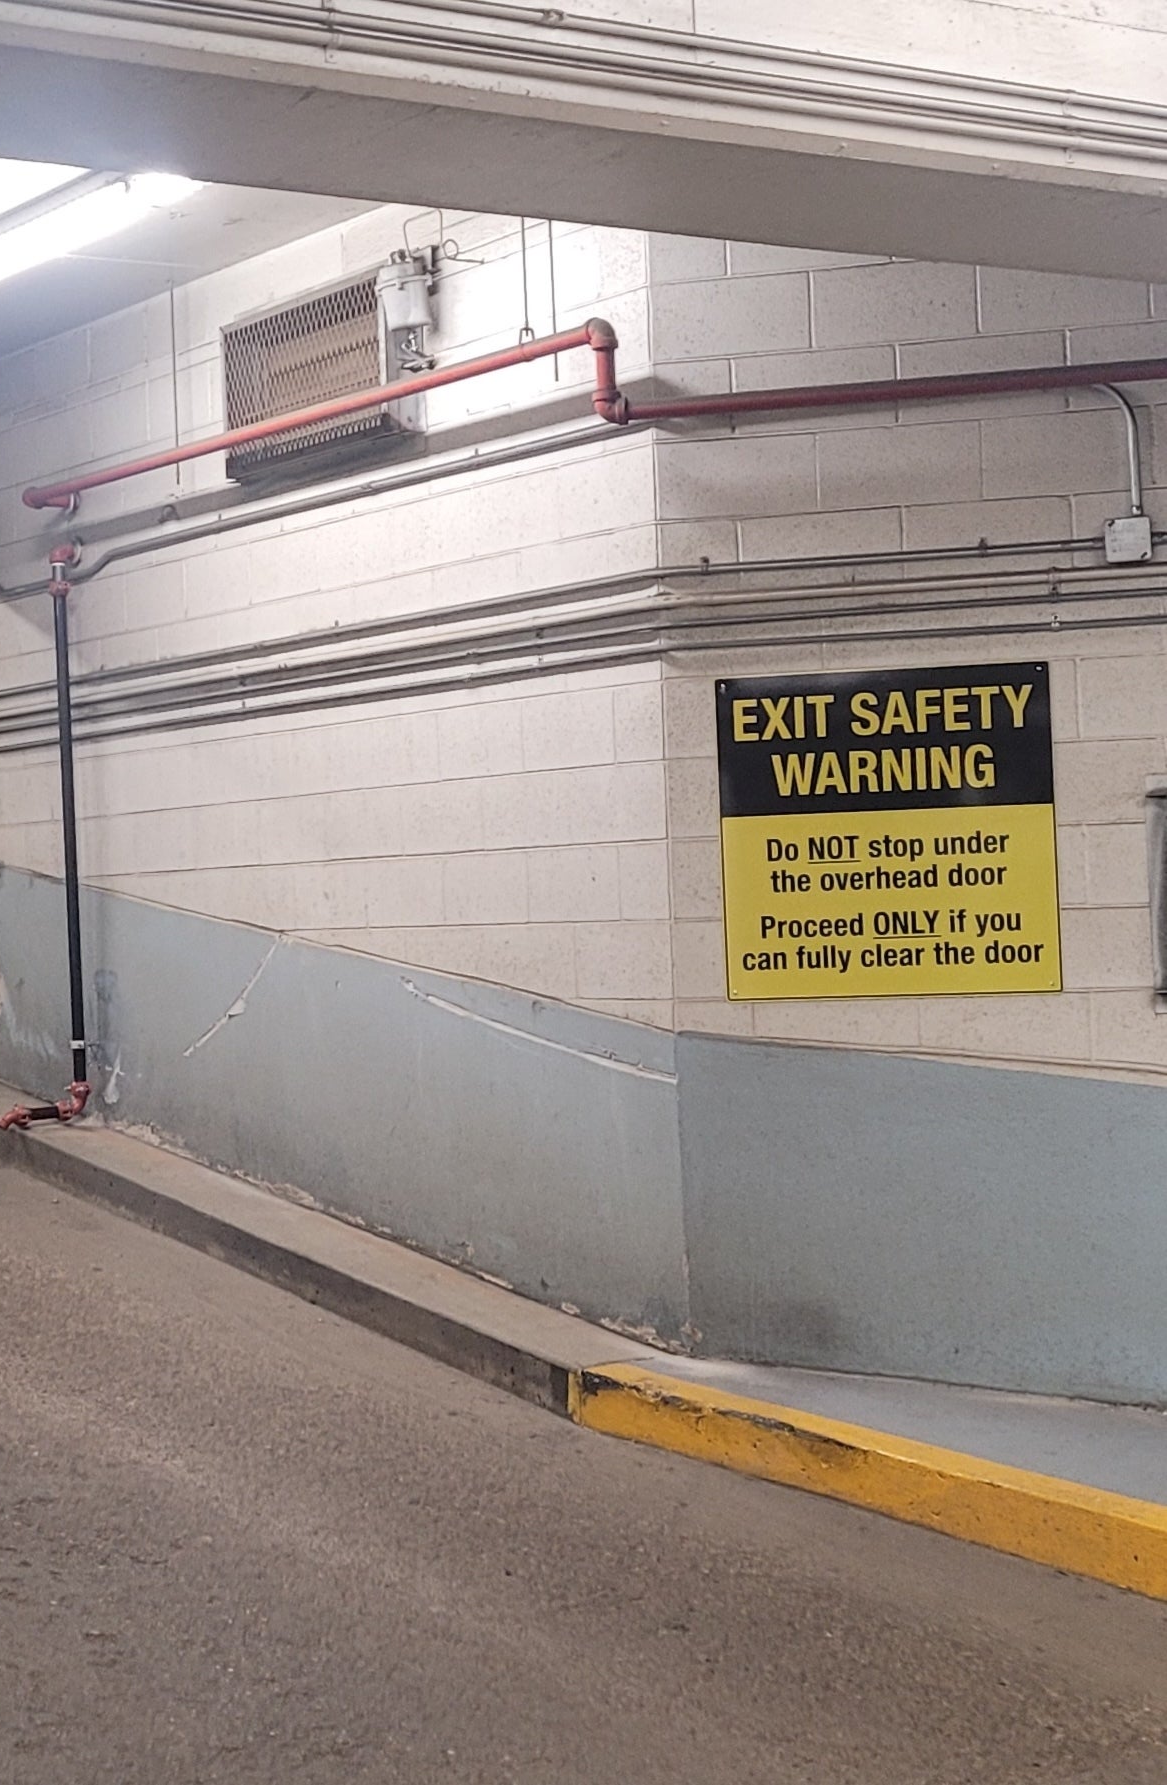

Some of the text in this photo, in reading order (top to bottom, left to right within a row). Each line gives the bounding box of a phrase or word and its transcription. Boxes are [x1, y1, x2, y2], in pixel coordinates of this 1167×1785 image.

[732, 684, 1033, 742] EXIT SAFETY
[771, 743, 995, 797] WARNING
[766, 830, 1009, 862] Do NOT stop under
[771, 863, 1007, 893] the overhead door
[761, 909, 1021, 939] Proceed ONLY if you
[742, 940, 1044, 973] can fully clear the door
